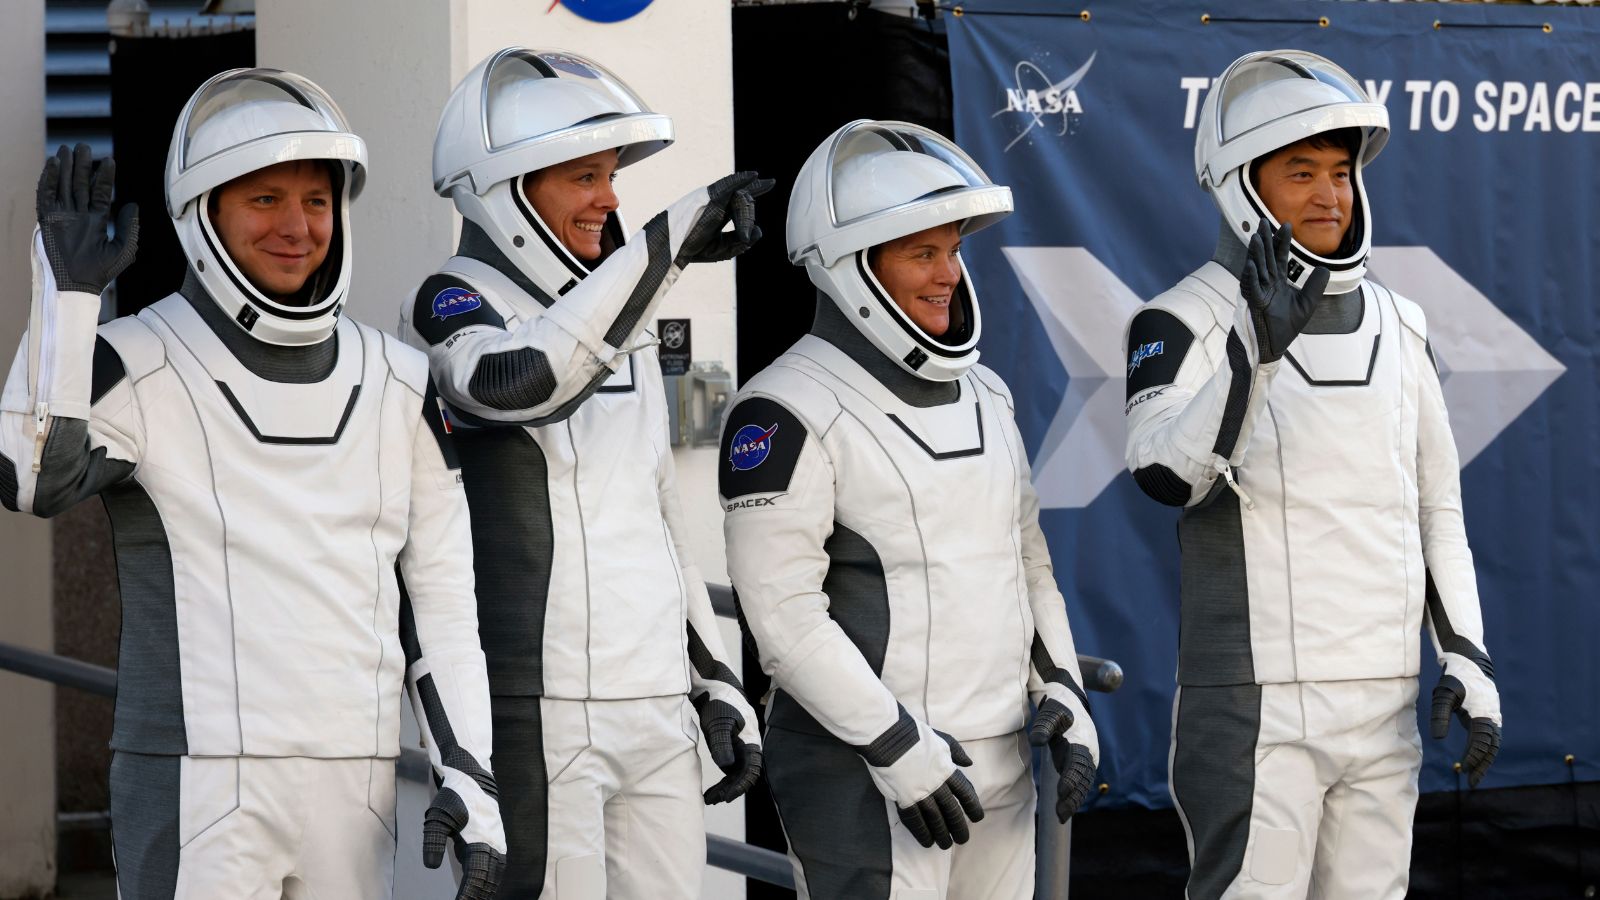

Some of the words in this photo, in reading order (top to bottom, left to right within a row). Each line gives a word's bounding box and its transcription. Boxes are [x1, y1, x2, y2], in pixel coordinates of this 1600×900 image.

[1006, 88, 1083, 113] NASA
[1405, 80, 1460, 132] TO
[1472, 80, 1600, 133] SPACE
[438, 296, 477, 310] NASA
[1125, 385, 1177, 416] SPACEX
[733, 441, 766, 456] NASA
[726, 493, 790, 513] SPACEX
